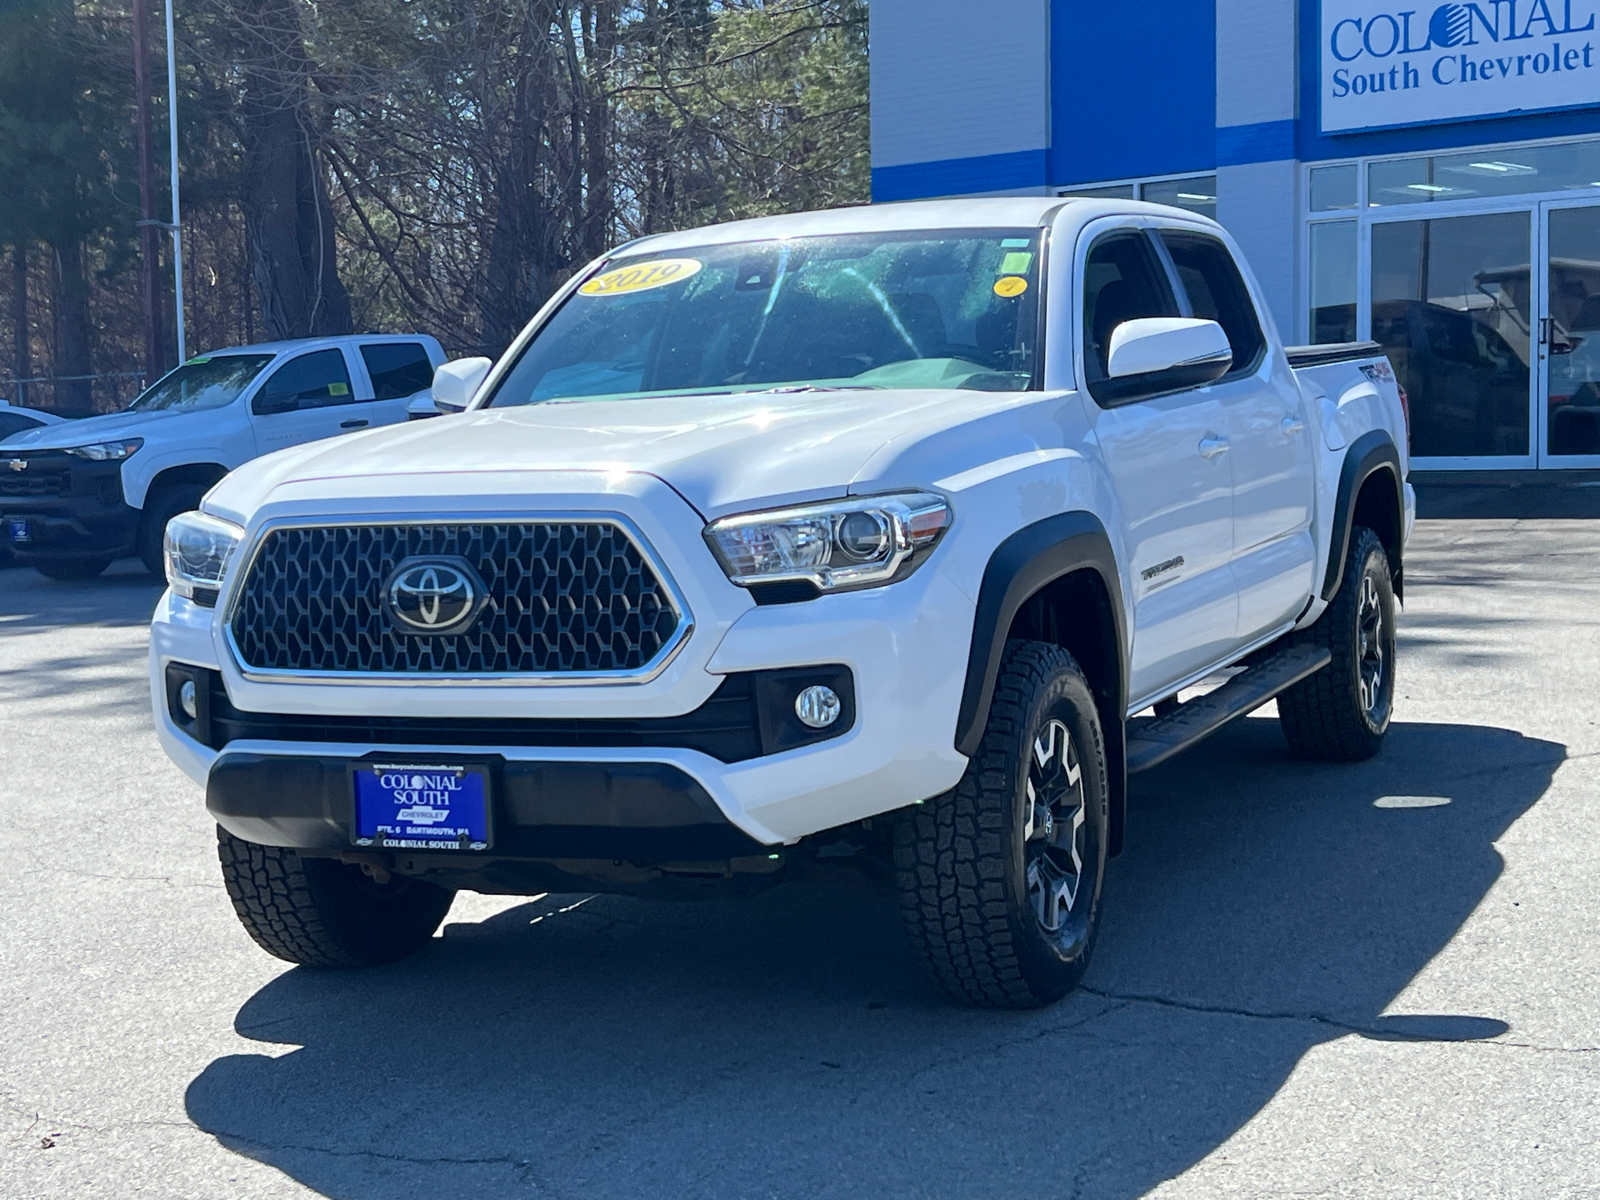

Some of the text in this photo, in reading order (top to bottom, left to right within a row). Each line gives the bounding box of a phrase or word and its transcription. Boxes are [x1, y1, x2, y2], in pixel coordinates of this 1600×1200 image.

[1330, 0, 1595, 62] COLONIAL
[1332, 41, 1594, 98] South Chevrolet
[592, 263, 682, 292] 2019
[380, 774, 462, 791] COLONIAL
[393, 790, 450, 805] SOUTH
[401, 810, 445, 819] CHEVROLET
[383, 839, 460, 849] COLONIAL SOUTH
